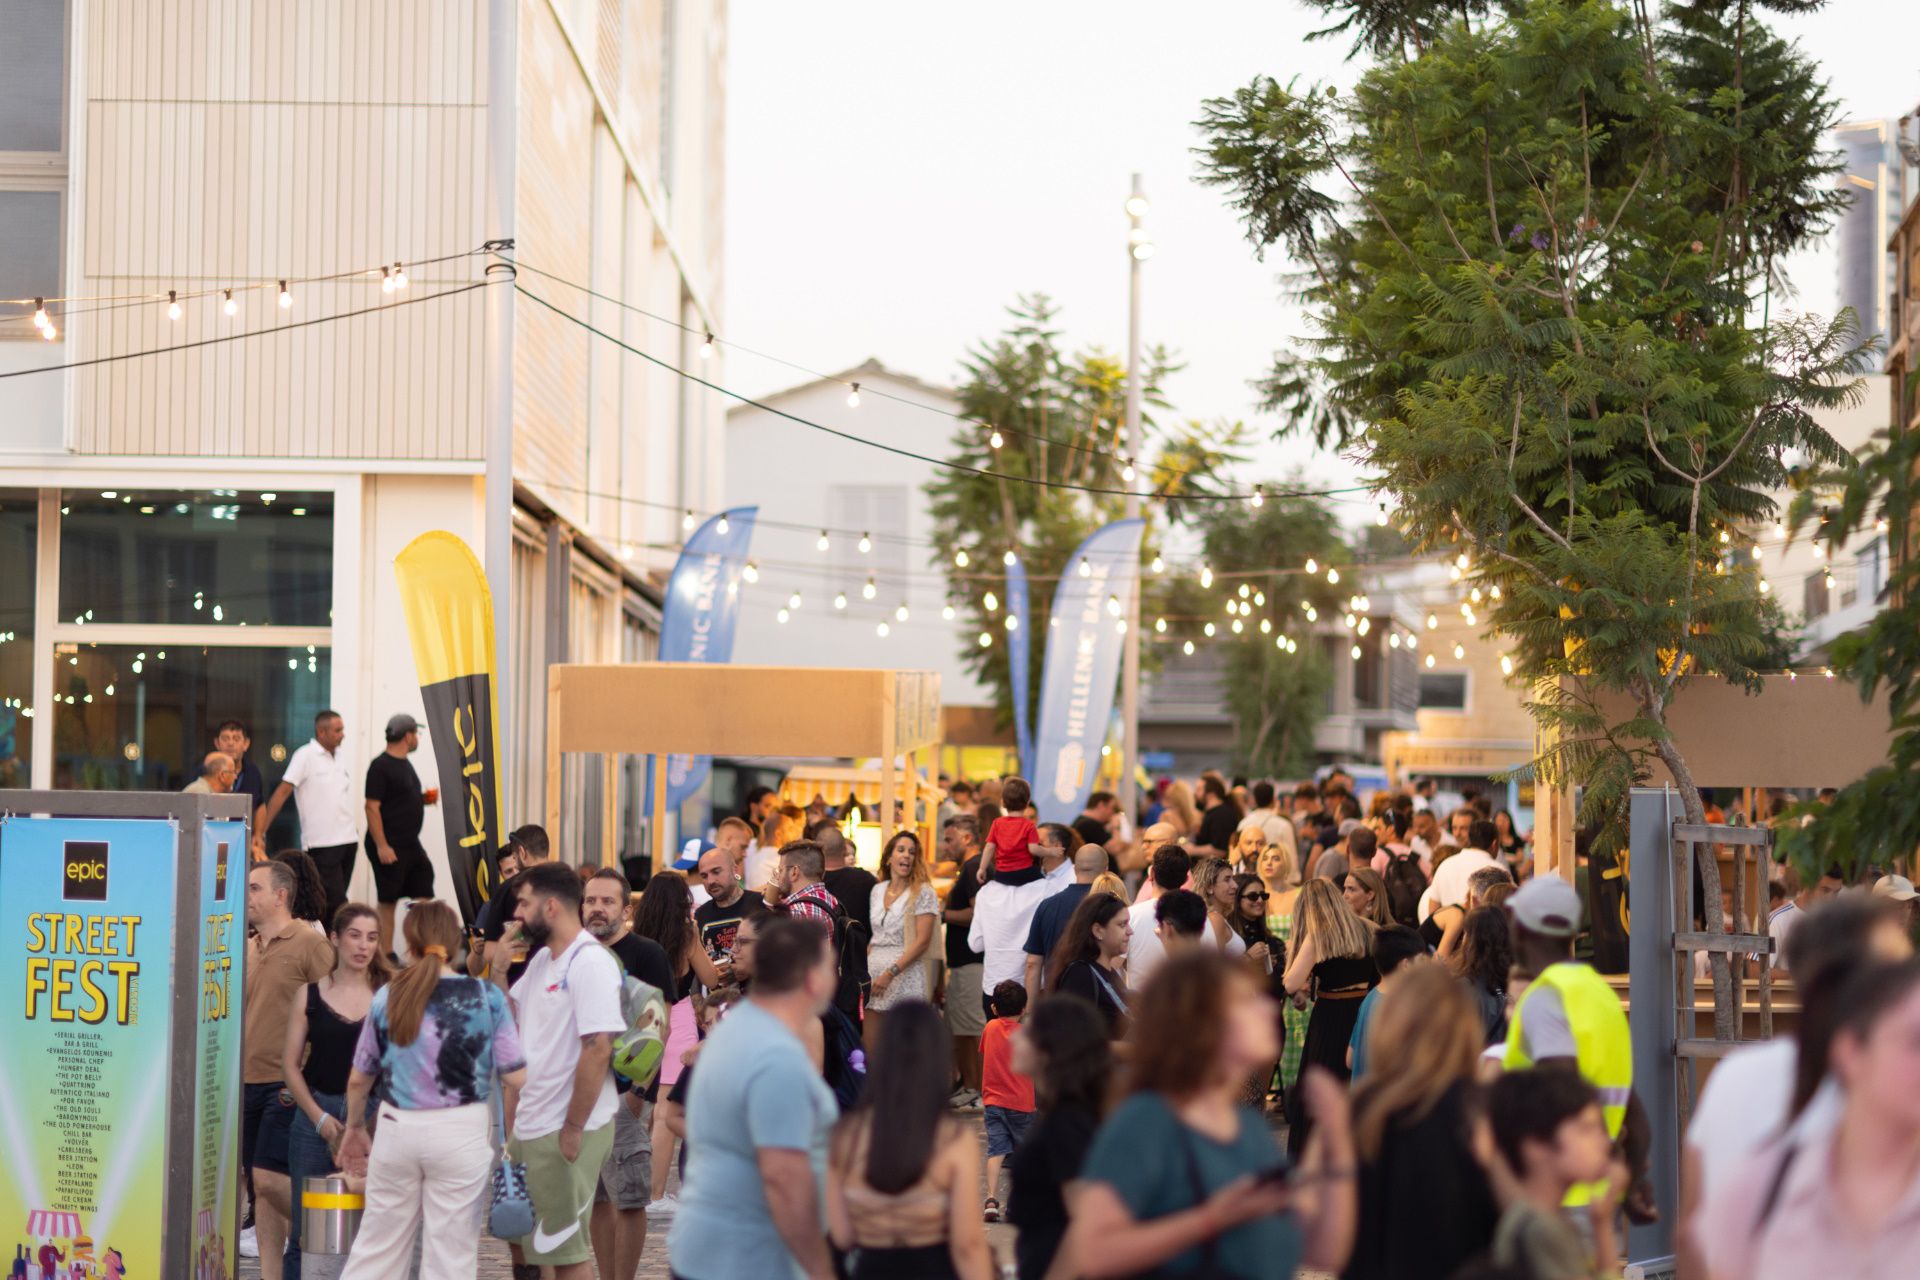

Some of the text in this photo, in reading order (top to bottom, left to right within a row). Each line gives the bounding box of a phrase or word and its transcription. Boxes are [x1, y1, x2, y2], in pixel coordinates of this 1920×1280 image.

[1081, 562, 1110, 624] BANK
[66, 859, 106, 882] epic
[26, 912, 142, 957] STREET
[25, 957, 140, 1026] FEST
[62, 1081, 96, 1089] QUATTRINO
[72, 1122, 112, 1131] POWERHOUSE
[61, 1146, 92, 1154] CARLSBERG
